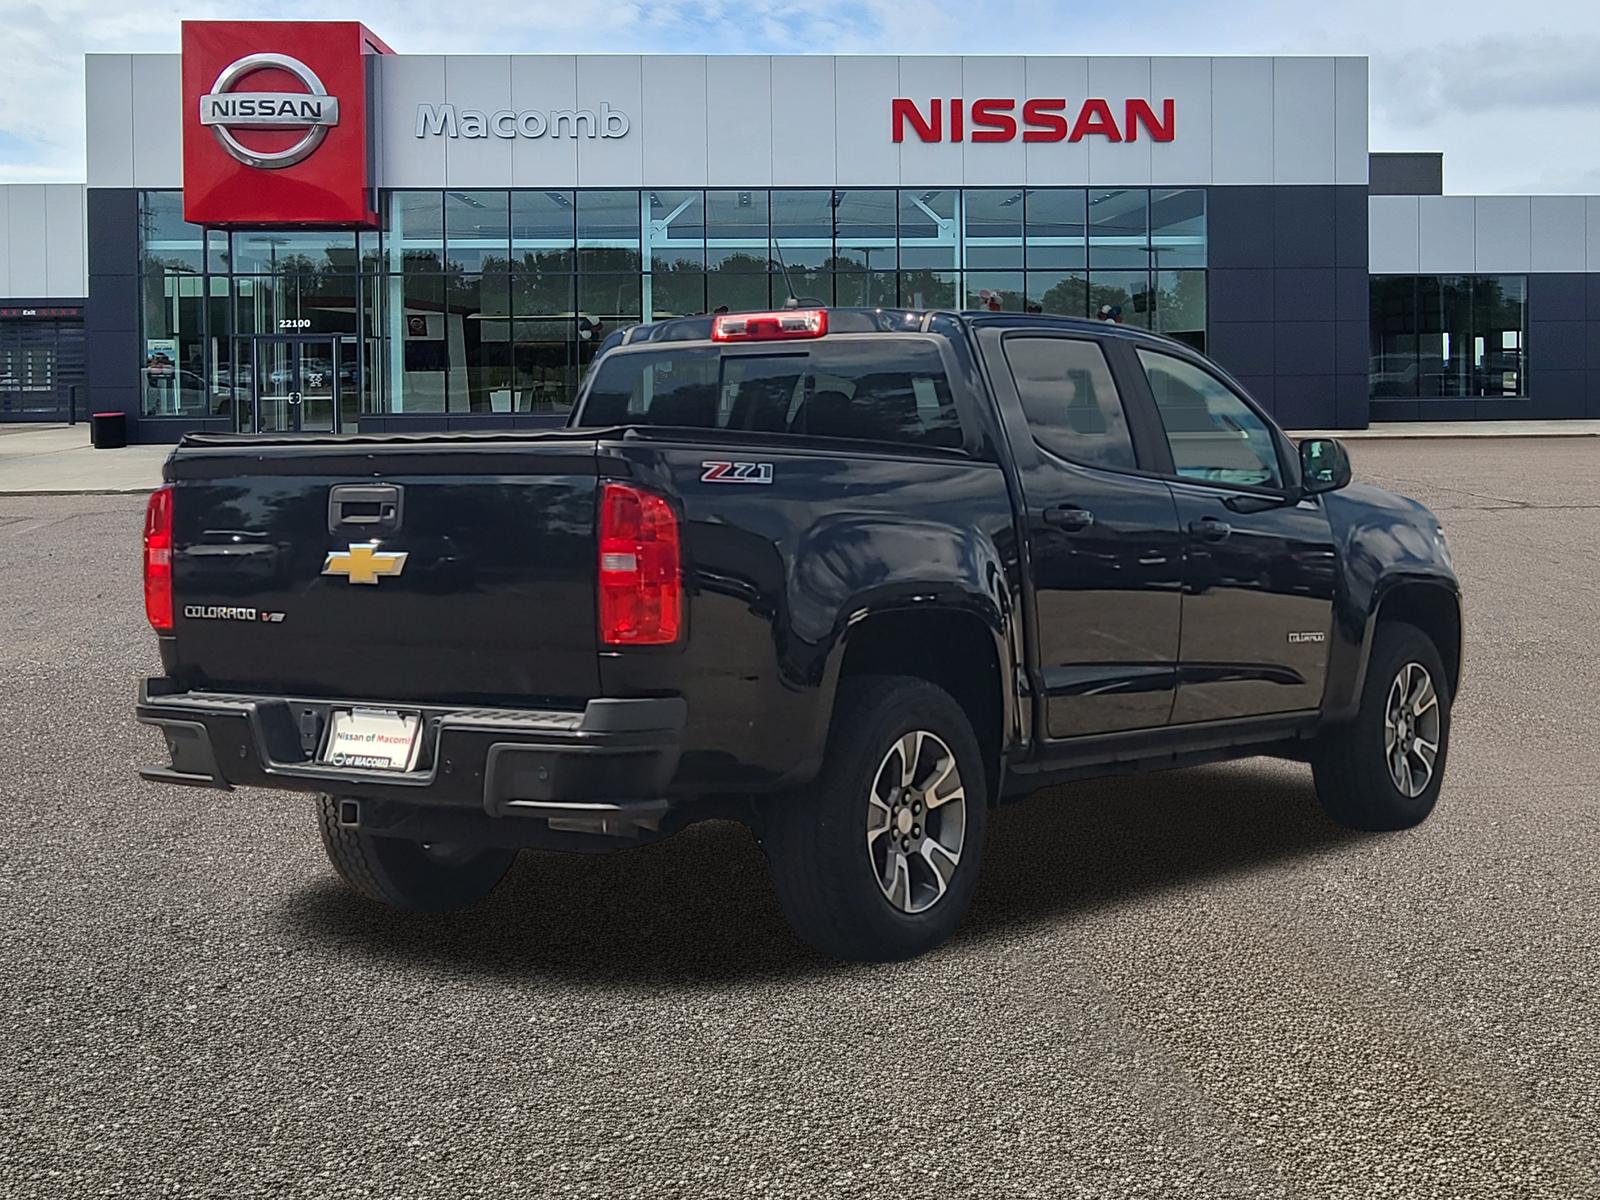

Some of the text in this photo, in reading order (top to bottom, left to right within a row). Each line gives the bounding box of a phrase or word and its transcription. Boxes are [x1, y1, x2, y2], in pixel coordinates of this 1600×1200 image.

[212, 100, 321, 117] NISSAN
[415, 102, 630, 138] Macomb
[892, 98, 1175, 143] NISSAN
[279, 319, 311, 328] 22100
[701, 461, 774, 484] Z71
[184, 605, 257, 620] COLORADO
[336, 731, 364, 741] Nissan
[366, 733, 376, 742] of
[354, 756, 390, 768] MACOMB
